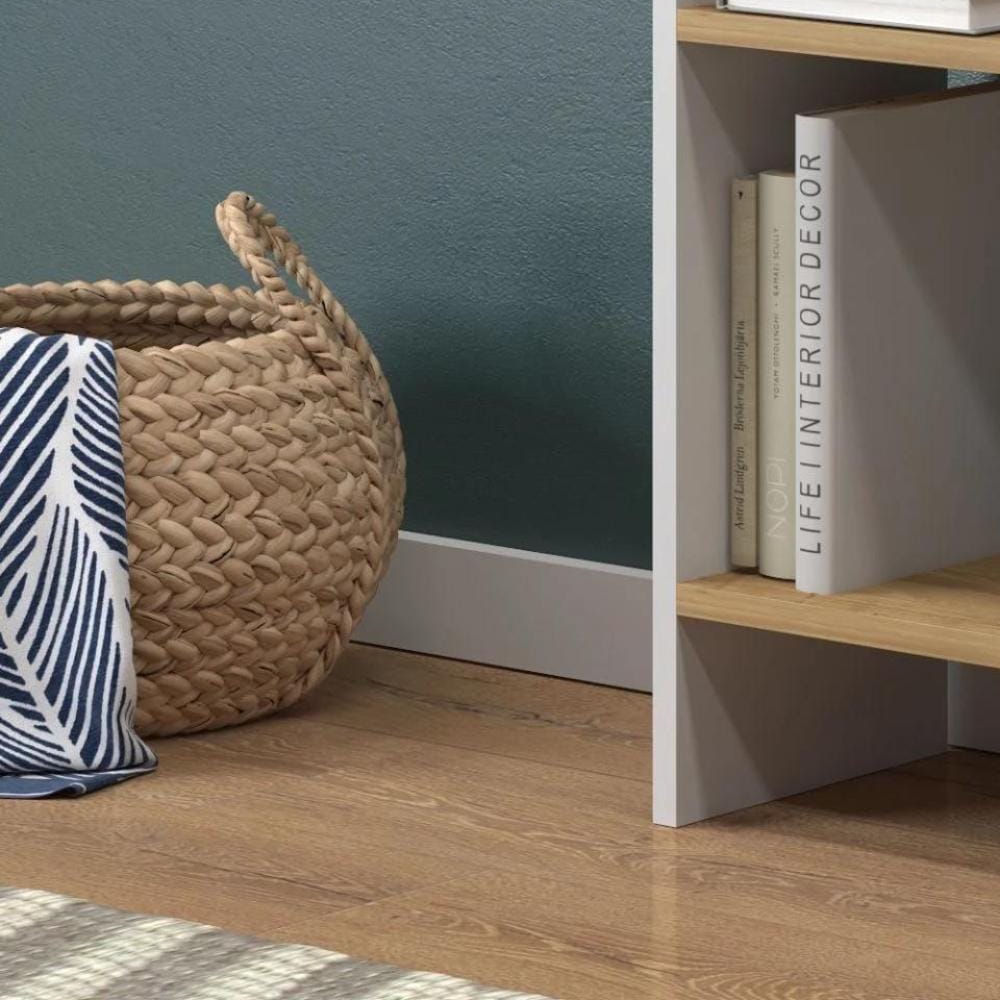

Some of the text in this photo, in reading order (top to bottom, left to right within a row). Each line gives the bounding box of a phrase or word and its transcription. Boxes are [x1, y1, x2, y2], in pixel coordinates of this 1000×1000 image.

[799, 154, 822, 269] DECOR
[799, 284, 821, 447] INTERIOR
[766, 456, 789, 539] NOPI
[799, 481, 821, 554] LIFE
